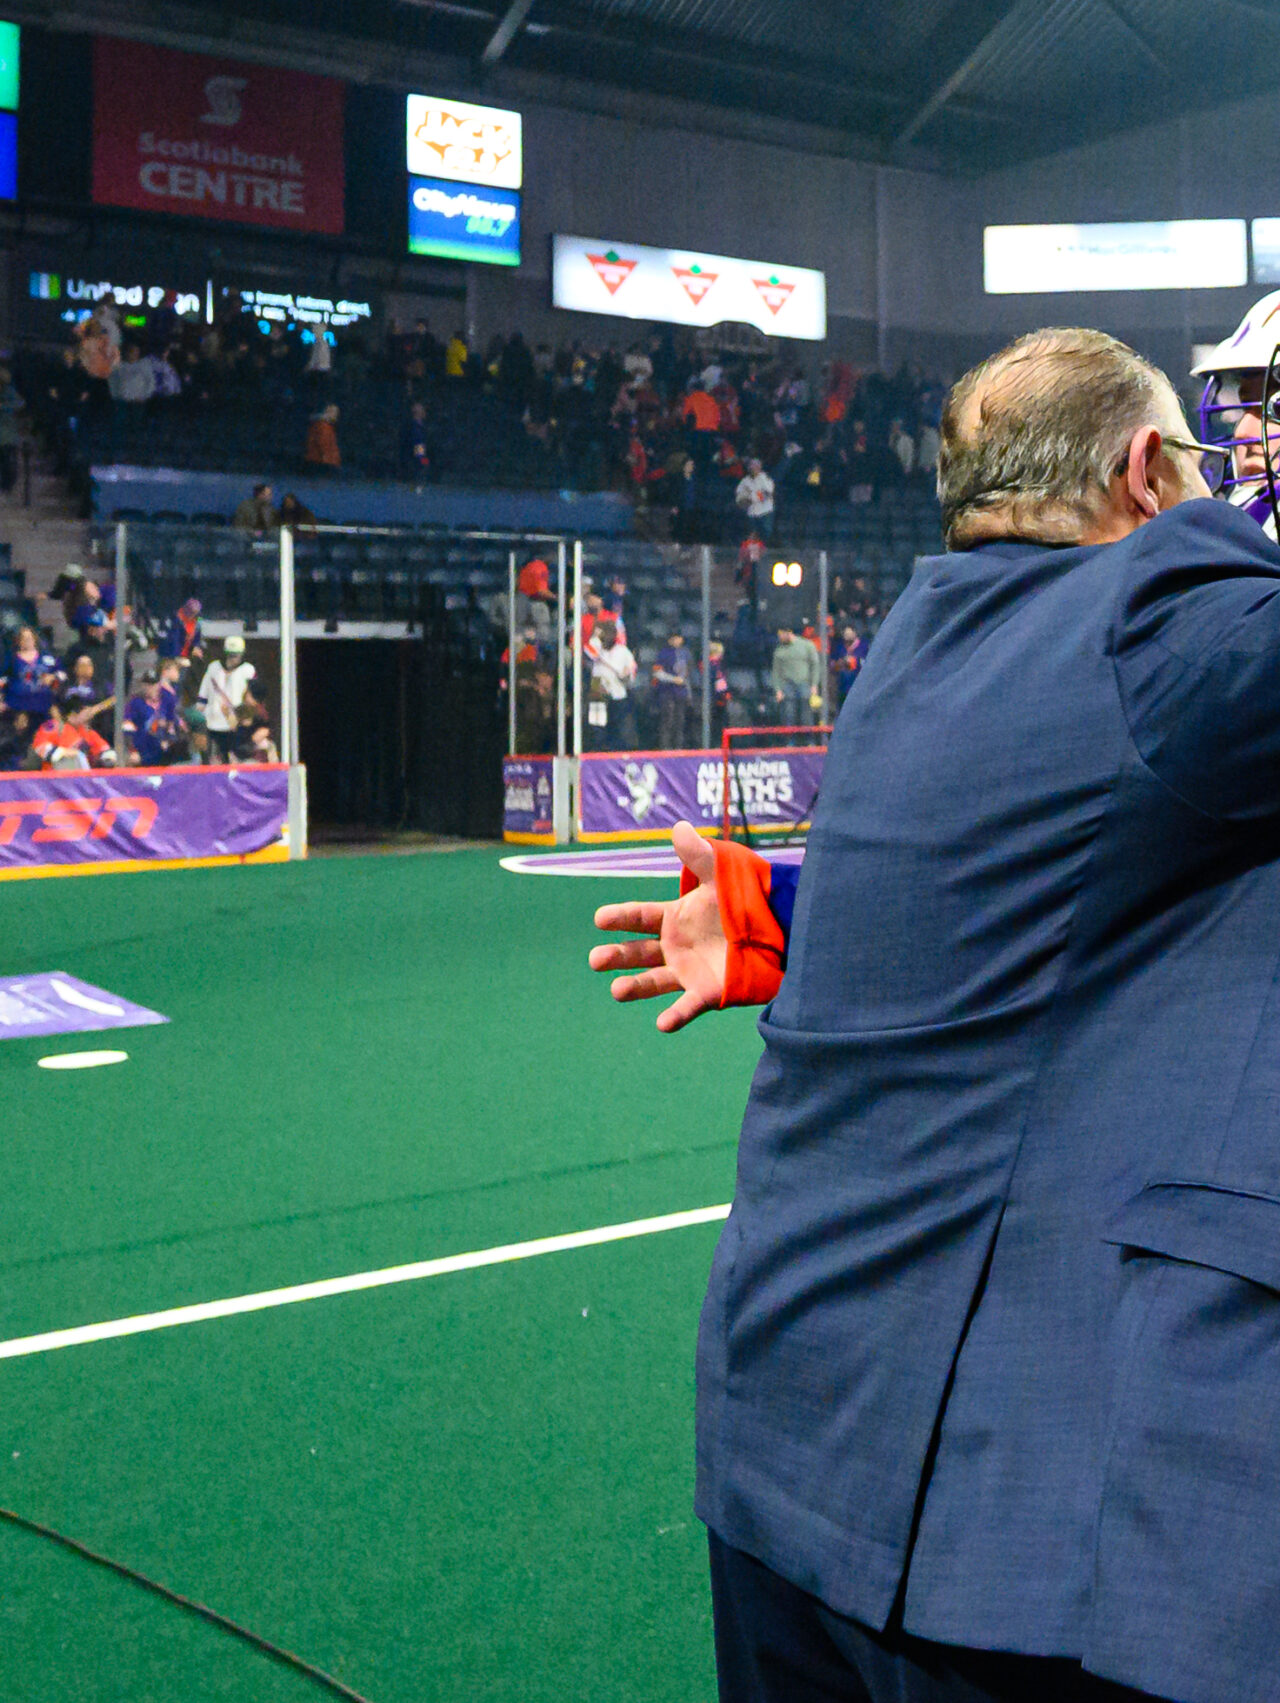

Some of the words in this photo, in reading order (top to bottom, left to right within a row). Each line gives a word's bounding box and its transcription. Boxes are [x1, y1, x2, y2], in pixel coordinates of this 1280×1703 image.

[139, 131, 304, 176] Scotiabank
[139, 161, 306, 214] CENTRE
[0, 796, 159, 845] TSN
